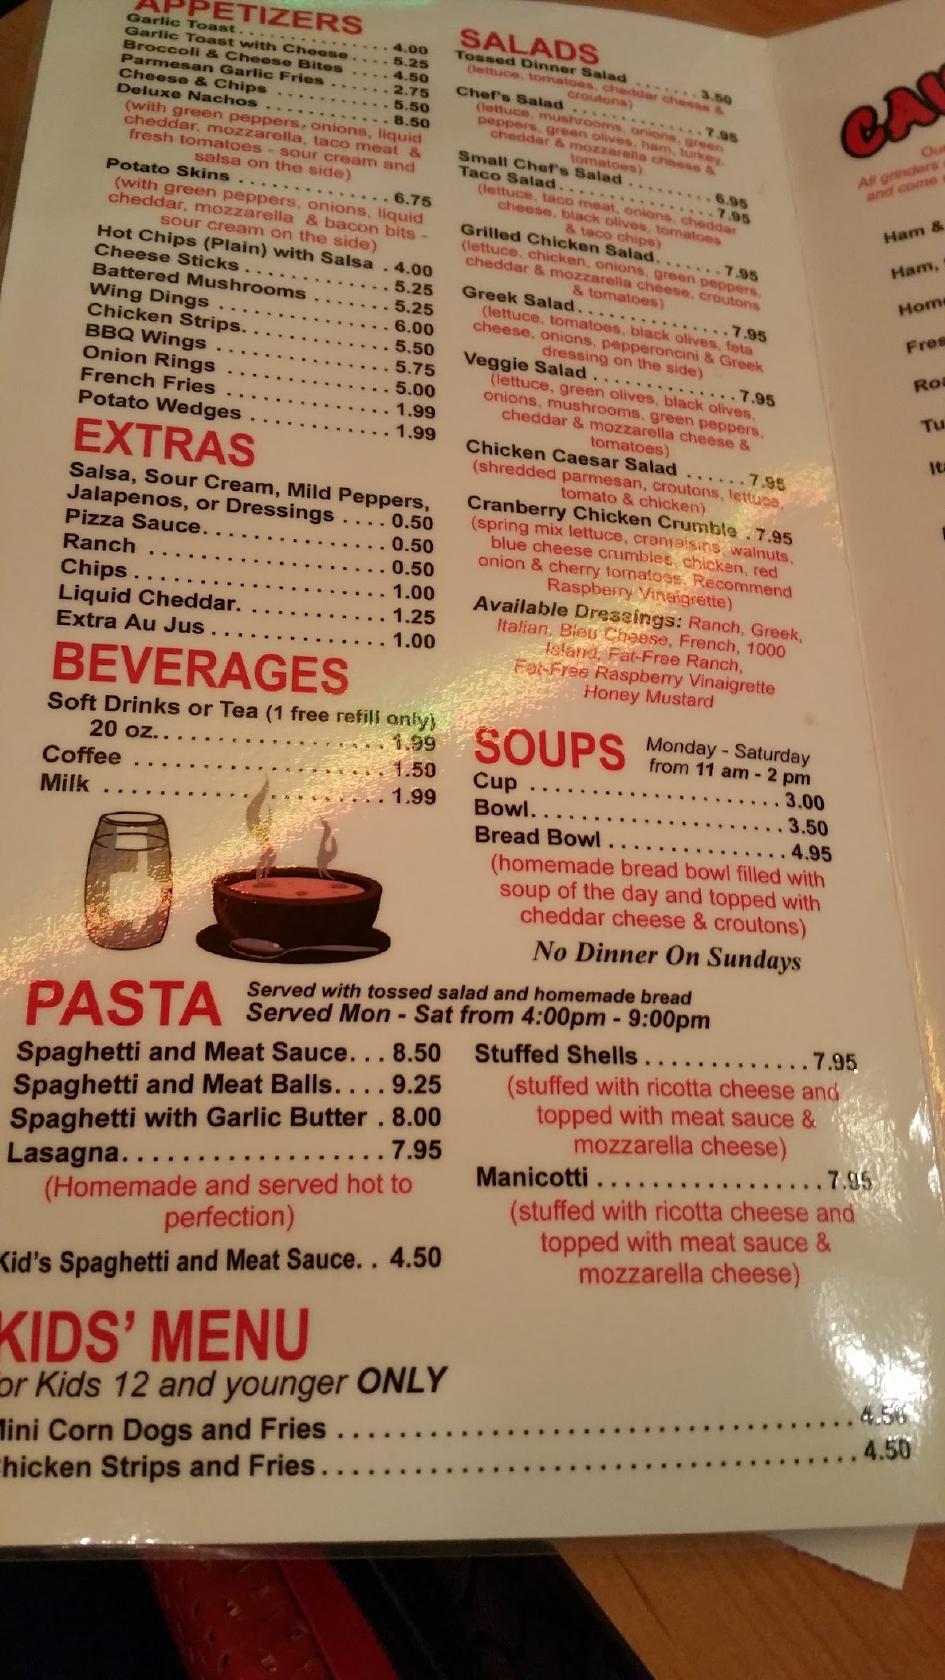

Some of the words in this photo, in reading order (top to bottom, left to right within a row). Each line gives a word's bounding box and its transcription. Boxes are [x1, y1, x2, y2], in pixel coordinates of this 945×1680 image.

[126, 12, 180, 27] Garlic
[186, 19, 234, 33] Toast
[392, 42, 428, 54] 4.00
[134, 0, 362, 34] APPETIZERS
[122, 38, 199, 56] Broccoli
[205, 48, 218, 58] &
[224, 50, 292, 66] Cheese
[297, 58, 343, 72] Bites
[393, 70, 428, 83] 4.50
[460, 28, 599, 64] SALADS
[456, 50, 515, 66] Tossed
[520, 58, 576, 74] Dinner
[581, 66, 627, 82] Salad
[701, 89, 732, 105] 3.50
[116, 82, 181, 98] Deluxe
[187, 90, 257, 107] Nachos
[394, 114, 430, 128] 8.50
[456, 86, 510, 102] Chef's
[516, 93, 563, 110] Salad
[705, 126, 738, 143] 7.95
[106, 157, 169, 174] Potato
[176, 164, 229, 181] Skins
[394, 192, 431, 207] 6.75
[194, 152, 240, 166] salsa
[246, 158, 269, 169] on
[274, 160, 302, 173] the
[308, 165, 351, 180] side)
[884, 225, 925, 244] Ham
[460, 223, 520, 242] Grilled
[526, 232, 599, 254] Chicken
[605, 243, 654, 262] Salad
[724, 264, 758, 282] 7.95
[891, 260, 939, 280] Ham,
[92, 262, 179, 284] Battered
[186, 272, 306, 299] Mushrooms
[394, 300, 433, 316] 5.25
[84, 323, 134, 342] BBQ
[140, 328, 206, 351] Wings
[395, 361, 435, 376] 5.75
[542, 344, 608, 367] dressing
[612, 356, 632, 366] on
[636, 357, 661, 371] the
[666, 362, 703, 379] side)
[463, 350, 528, 372] Veggie
[534, 360, 586, 378] Salad
[740, 390, 775, 407] 7.95
[74, 418, 254, 467] EXTRAS
[68, 461, 136, 484] Salsa,
[144, 468, 198, 487] Sour
[204, 474, 279, 498] Cream,
[287, 482, 330, 500] Mild
[338, 486, 429, 512] Peppers,
[62, 532, 135, 553] Ranch
[392, 560, 434, 576] 0.50
[58, 583, 131, 606] Liquid
[138, 588, 236, 611] Cheddar
[393, 608, 435, 624] 1.25
[52, 640, 348, 695] BEVERAGES
[47, 691, 96, 711] Soft
[104, 694, 180, 714] Drinks
[188, 702, 213, 716] or
[219, 700, 258, 718] Tea
[266, 704, 282, 723] (1
[290, 705, 329, 722] free
[89, 718, 117, 737] 20
[42, 744, 121, 765] Coffee
[474, 726, 625, 771] SOUPS
[646, 736, 716, 759] Monday
[734, 742, 810, 768] Saturday
[40, 772, 89, 792] Milk
[649, 758, 688, 774] from
[696, 761, 713, 776] 11
[720, 766, 748, 779] am
[767, 766, 776, 782] 2
[782, 772, 810, 786] pm
[472, 771, 516, 794] Cup
[784, 792, 824, 810] 3.00
[474, 799, 528, 817] Bowl
[788, 818, 828, 836] 3.50
[475, 825, 539, 844] Bread
[547, 828, 600, 847] Bowl
[791, 843, 832, 862] 4.95
[532, 940, 566, 961] No
[574, 941, 658, 964] Dinner
[665, 944, 699, 966] On
[706, 946, 800, 975] Sundays
[25, 979, 222, 1026] PASTA
[246, 980, 316, 998] Served
[321, 982, 361, 998] with
[367, 984, 432, 999] tossed
[437, 984, 488, 1000] salad
[493, 986, 528, 1000] and
[534, 986, 635, 1004] homemade
[640, 988, 692, 1005] bread
[246, 1002, 332, 1022] Served
[338, 1003, 390, 1022] Mon
[414, 1004, 453, 1023] Sat
[460, 1004, 513, 1024] from
[520, 1005, 605, 1030] 4:00pm
[628, 1008, 710, 1032] 9:00pm
[16, 1040, 140, 1066] Spaghetti
[148, 1040, 195, 1061] and
[204, 1040, 264, 1061] Meat
[272, 1040, 347, 1062] Sauce
[392, 1042, 440, 1062] 8.50
[474, 1044, 558, 1063] Stuffed
[567, 1044, 637, 1065] Shells
[813, 1051, 857, 1070] 7.95
[507, 1074, 588, 1099] (stuffed
[595, 1076, 639, 1096] with
[646, 1078, 712, 1097] ricotta
[719, 1078, 794, 1100] cheese
[802, 1082, 840, 1102] and
[7, 1141, 118, 1167] Lasagna
[391, 1140, 441, 1160] 7.95
[574, 1134, 693, 1155] mozzarella
[700, 1134, 786, 1162] cheese)
[44, 1174, 196, 1202] (Homemade
[204, 1173, 250, 1196] and
[258, 1172, 338, 1195] served
[347, 1172, 383, 1194] hot
[390, 1173, 412, 1194] to
[476, 1166, 587, 1187] Manicotti
[164, 1204, 294, 1233] perfection)
[59, 1249, 169, 1278] Spaghetti
[176, 1248, 218, 1271] and
[226, 1248, 280, 1270] Meat
[286, 1247, 355, 1270] Sauce
[390, 1246, 441, 1268] 4.50
[151, 1307, 308, 1362] MENU
[34, 1370, 101, 1397] Kids
[115, 1370, 149, 1397] 12
[158, 1369, 216, 1397] and
[222, 1374, 349, 1403] younger
[357, 1365, 448, 1394] ONLY
[48, 1418, 112, 1441] Corn
[123, 1418, 192, 1446] Dogs
[201, 1417, 250, 1440] and
[260, 1416, 326, 1439] Fries
[100, 1454, 180, 1483] Strips
[189, 1453, 239, 1477] and
[248, 1453, 314, 1476] Fries
[864, 1438, 911, 1460] 4.50
